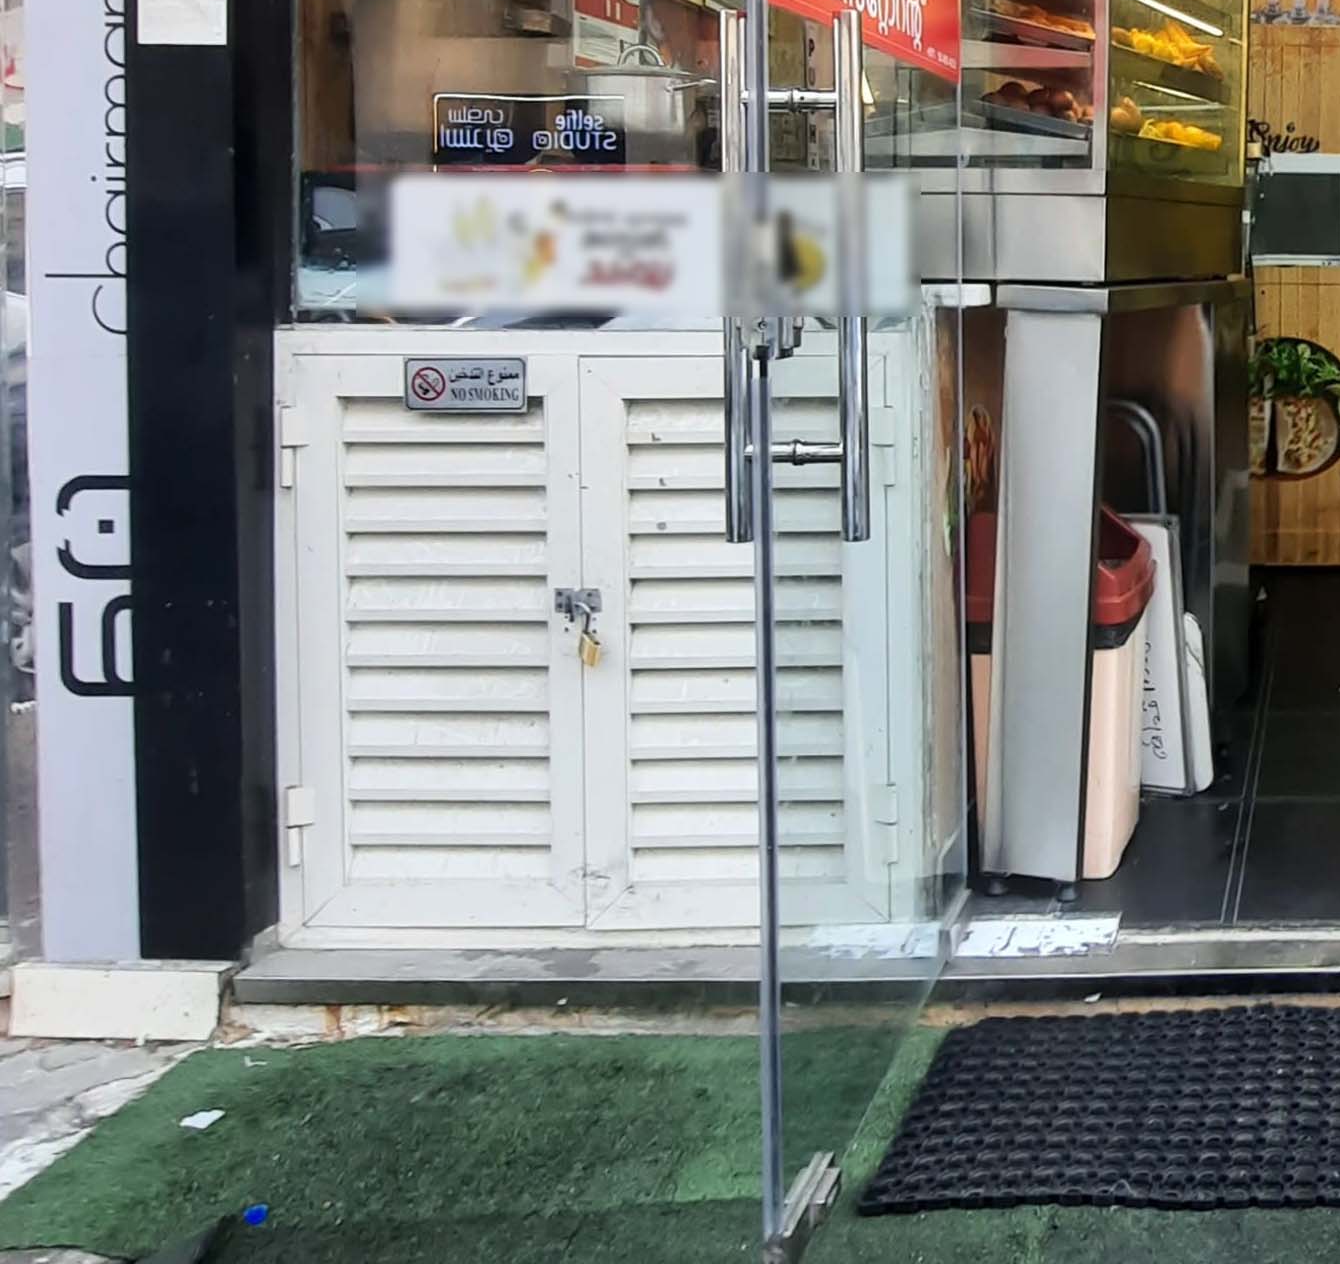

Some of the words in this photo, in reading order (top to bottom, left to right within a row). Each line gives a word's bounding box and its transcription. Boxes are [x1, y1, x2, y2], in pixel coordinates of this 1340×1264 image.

[487, 366, 520, 386] ممنوع
[450, 387, 467, 401] NO
[468, 387, 520, 402] SMOKING
